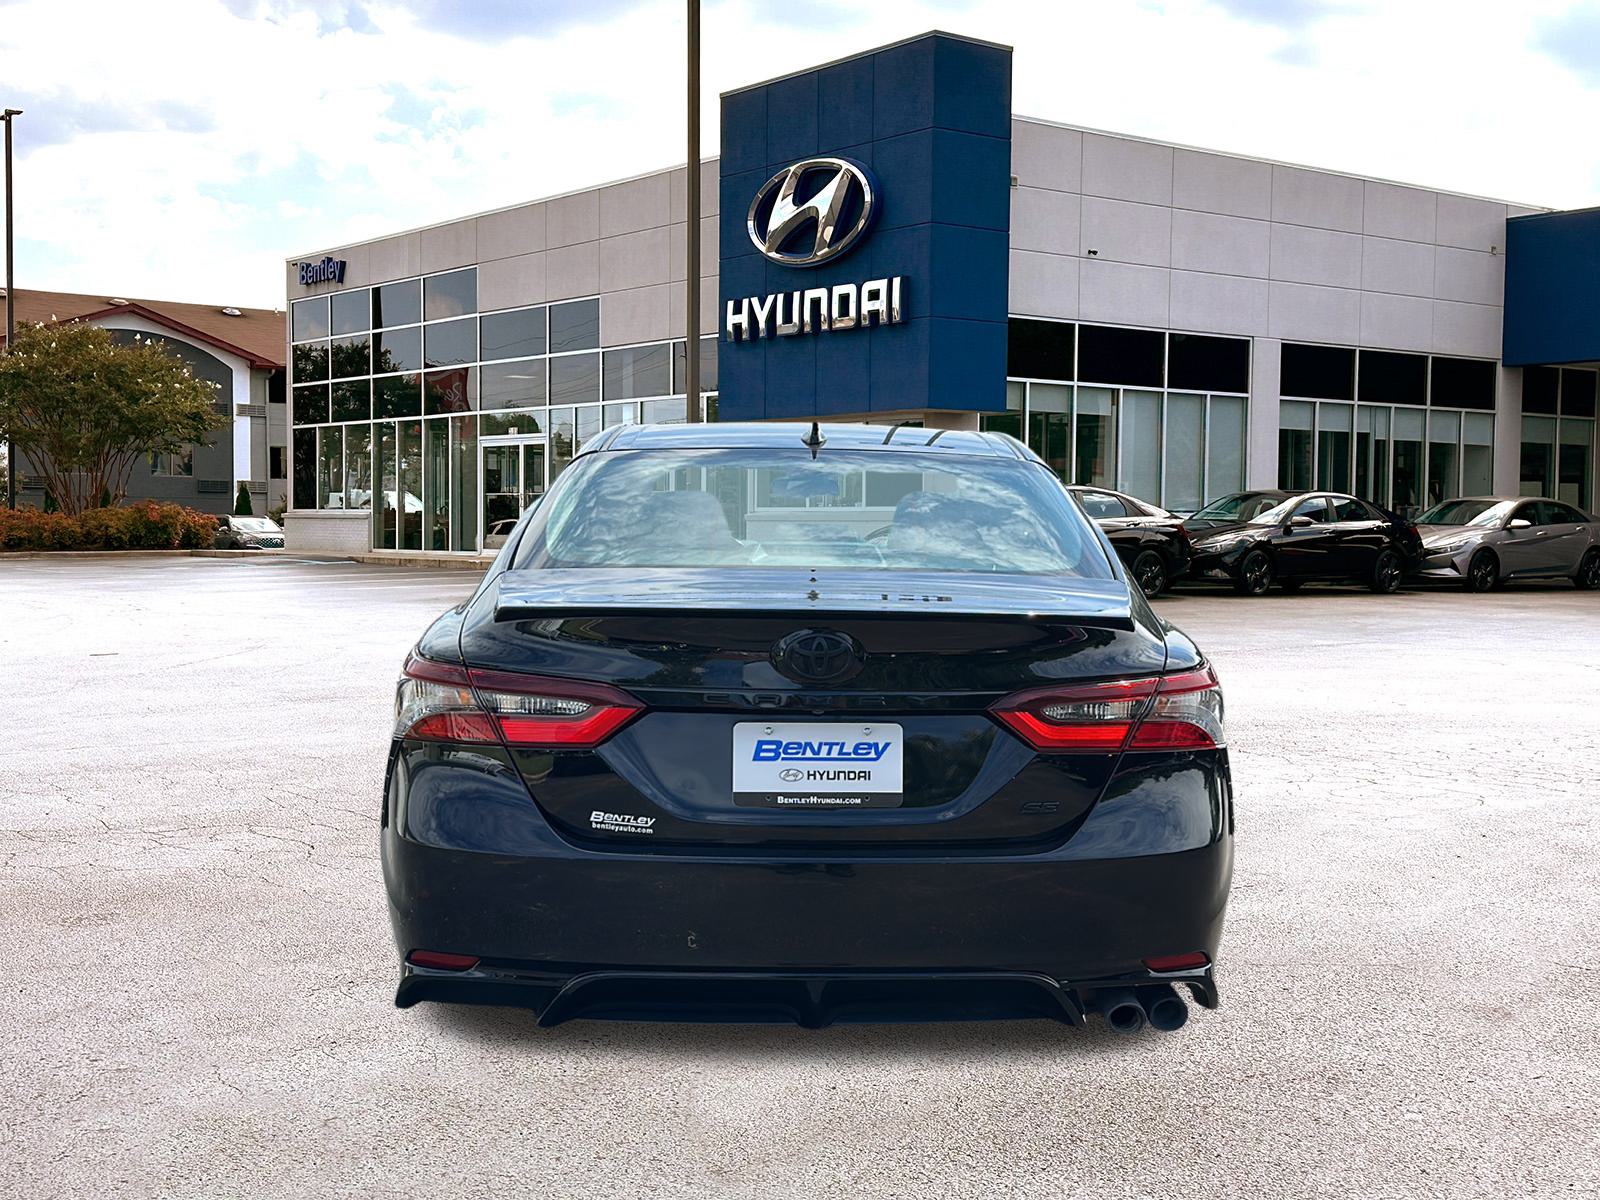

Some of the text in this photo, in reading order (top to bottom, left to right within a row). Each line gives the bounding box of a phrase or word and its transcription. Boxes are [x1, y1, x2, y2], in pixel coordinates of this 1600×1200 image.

[299, 257, 343, 285] Bentley
[726, 276, 902, 342] HYUNDAI
[807, 770, 871, 781] HYUNDAI
[591, 822, 654, 834] bentleyauto.com
